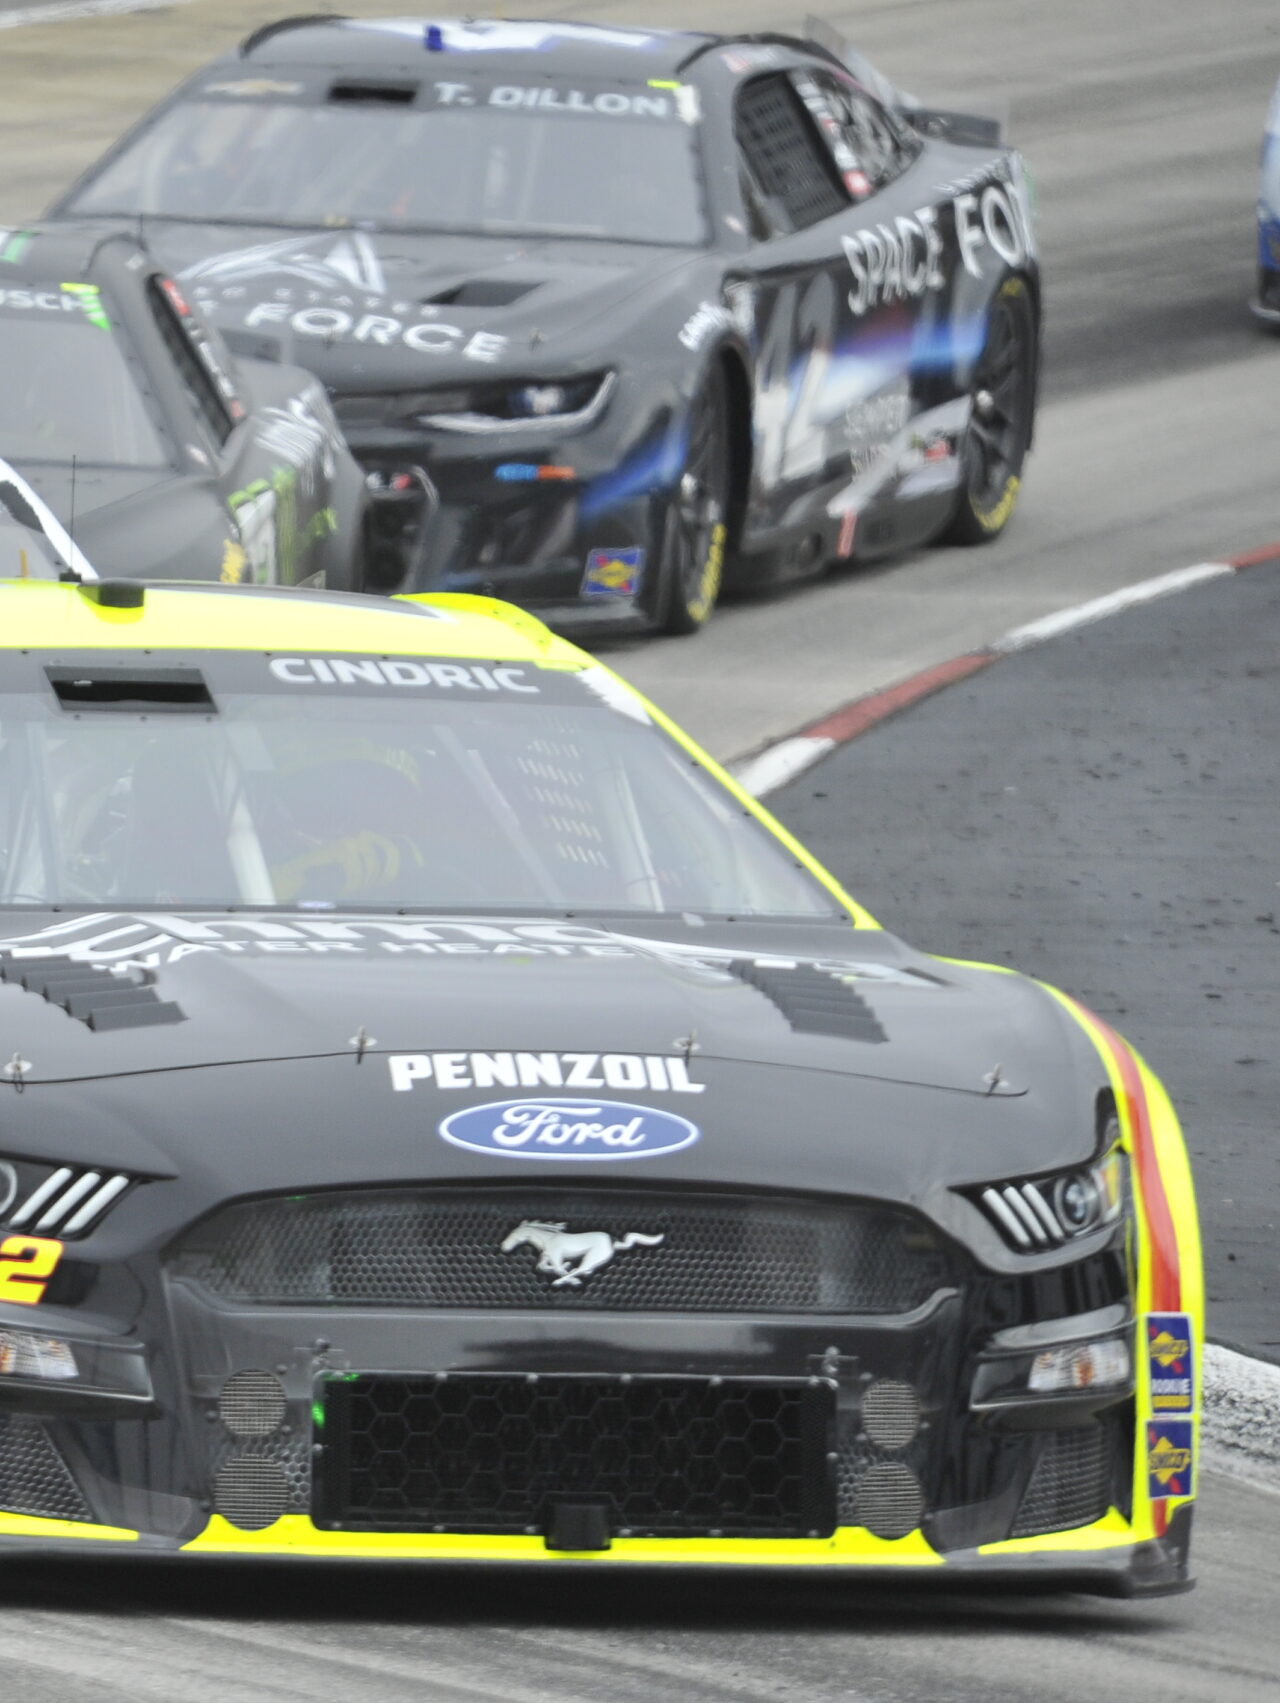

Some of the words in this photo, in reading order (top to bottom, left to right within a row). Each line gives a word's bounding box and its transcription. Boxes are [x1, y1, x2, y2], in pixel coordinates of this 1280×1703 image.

[434, 82, 475, 106] T.
[488, 86, 667, 117] DILLON
[840, 206, 945, 317] SPACE
[244, 302, 510, 363] FORCE
[270, 658, 540, 693] CINDRIC
[388, 1052, 706, 1093] PENNZOIL
[492, 1104, 647, 1147] Ford
